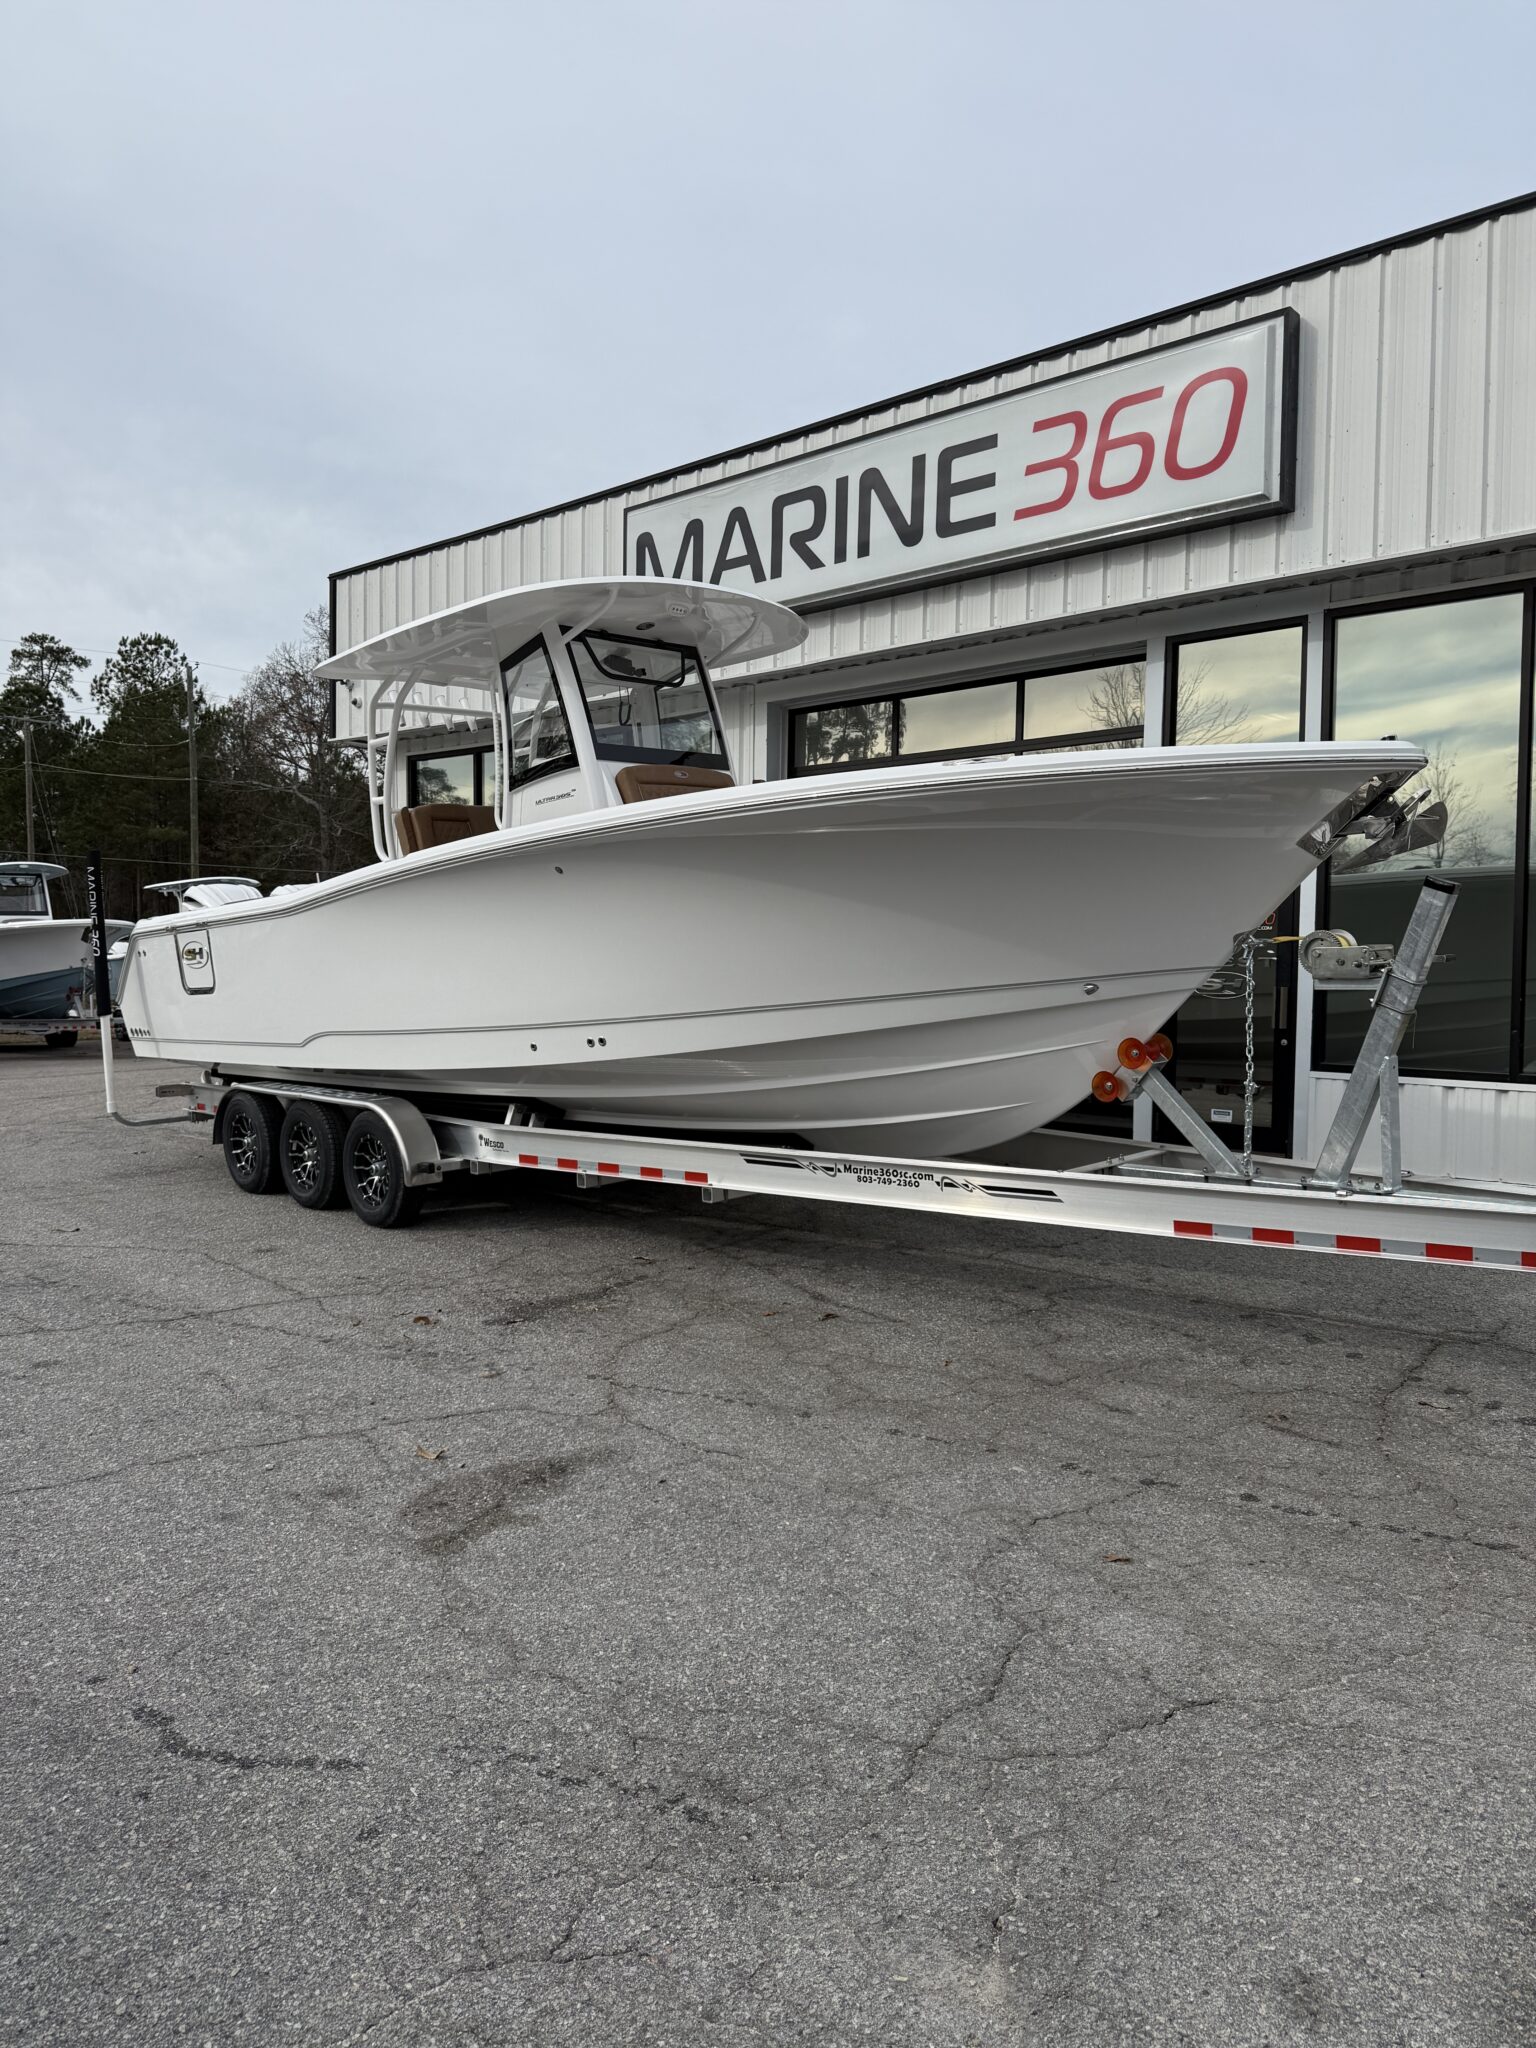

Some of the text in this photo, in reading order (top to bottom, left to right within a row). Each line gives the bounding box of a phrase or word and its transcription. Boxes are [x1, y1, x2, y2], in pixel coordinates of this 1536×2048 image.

[635, 366, 1249, 586] MARINE 360
[843, 1163, 934, 1181] Marine360sc.com
[857, 1175, 920, 1188] 803-749-2360
